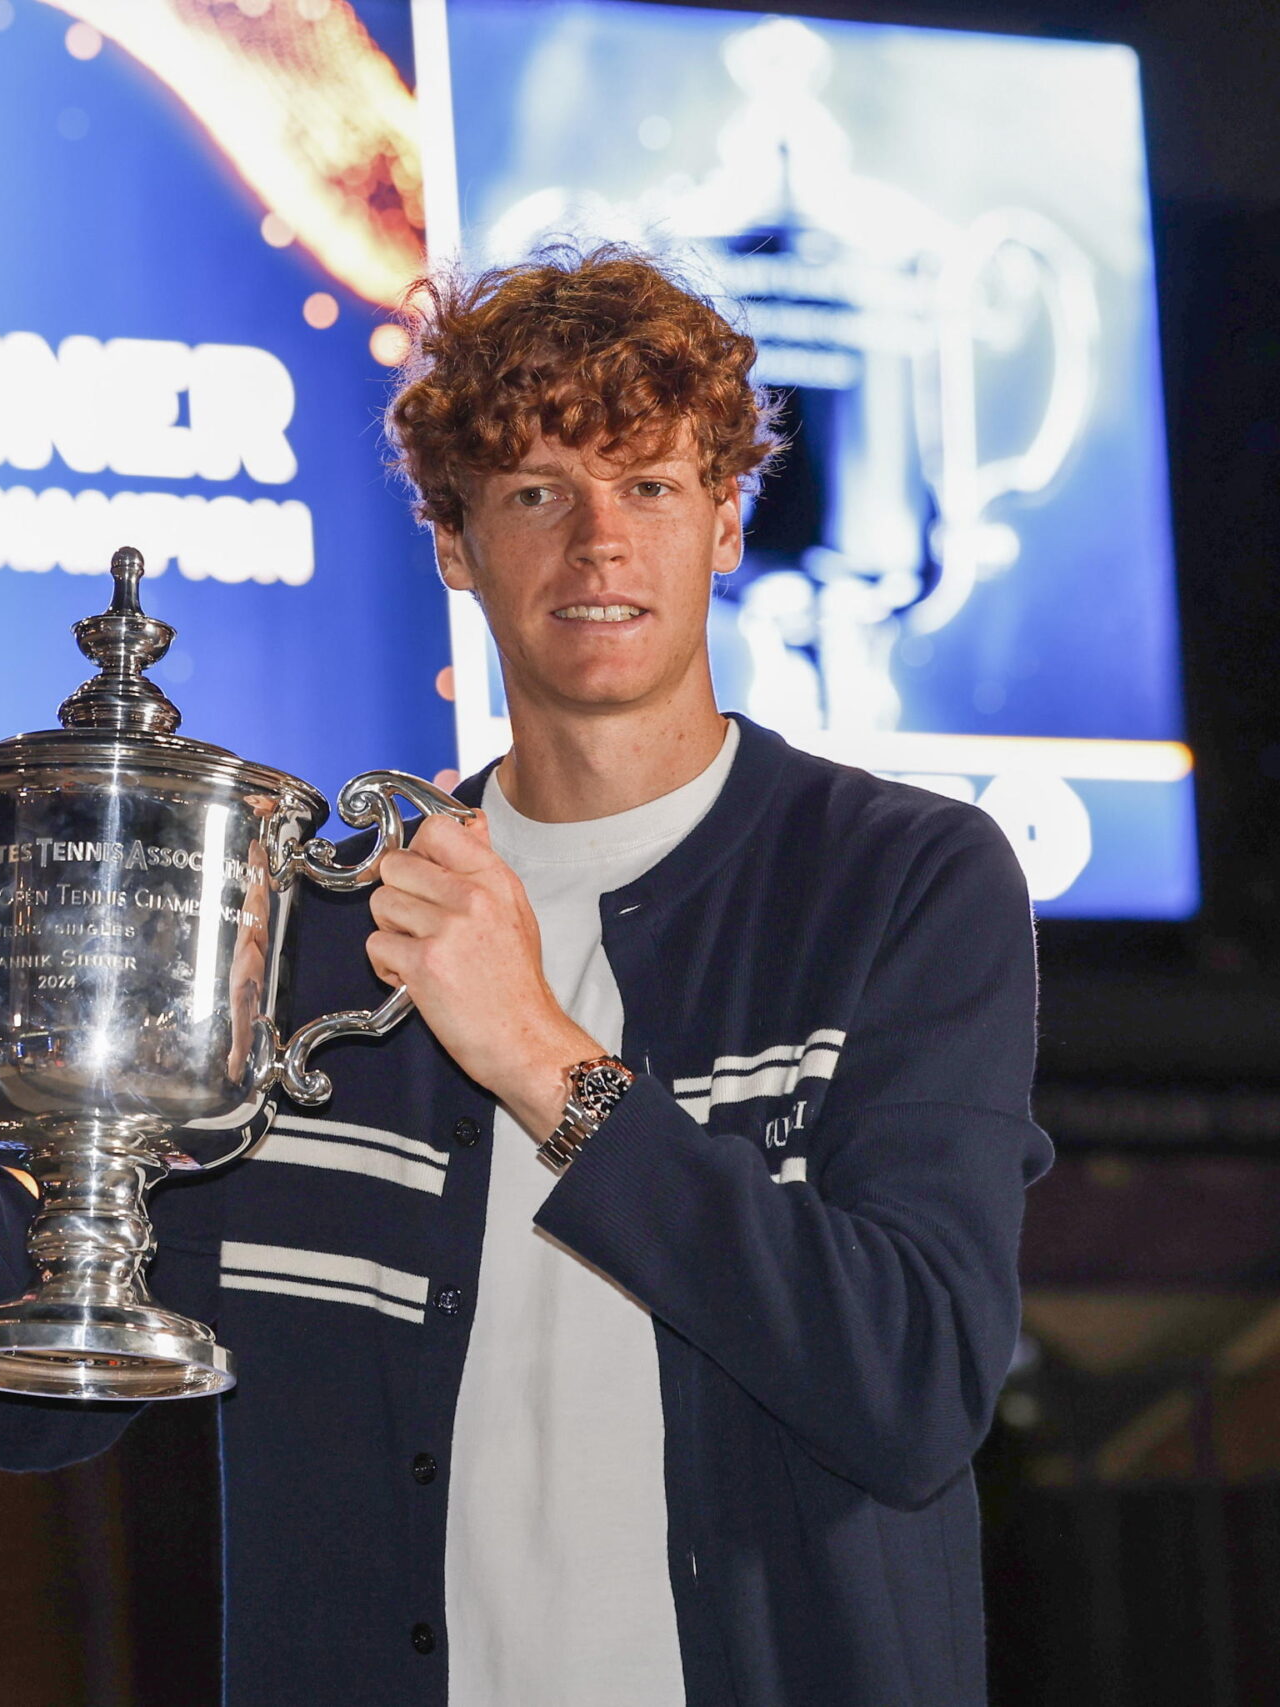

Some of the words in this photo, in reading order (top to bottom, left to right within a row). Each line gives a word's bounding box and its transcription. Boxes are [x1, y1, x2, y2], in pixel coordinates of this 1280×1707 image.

[36, 838, 124, 868] TENNIS
[124, 840, 263, 886] ASSOCTION
[57, 884, 126, 906] TENNIS
[60, 949, 137, 970] SINNER
[38, 975, 77, 989] 2024
